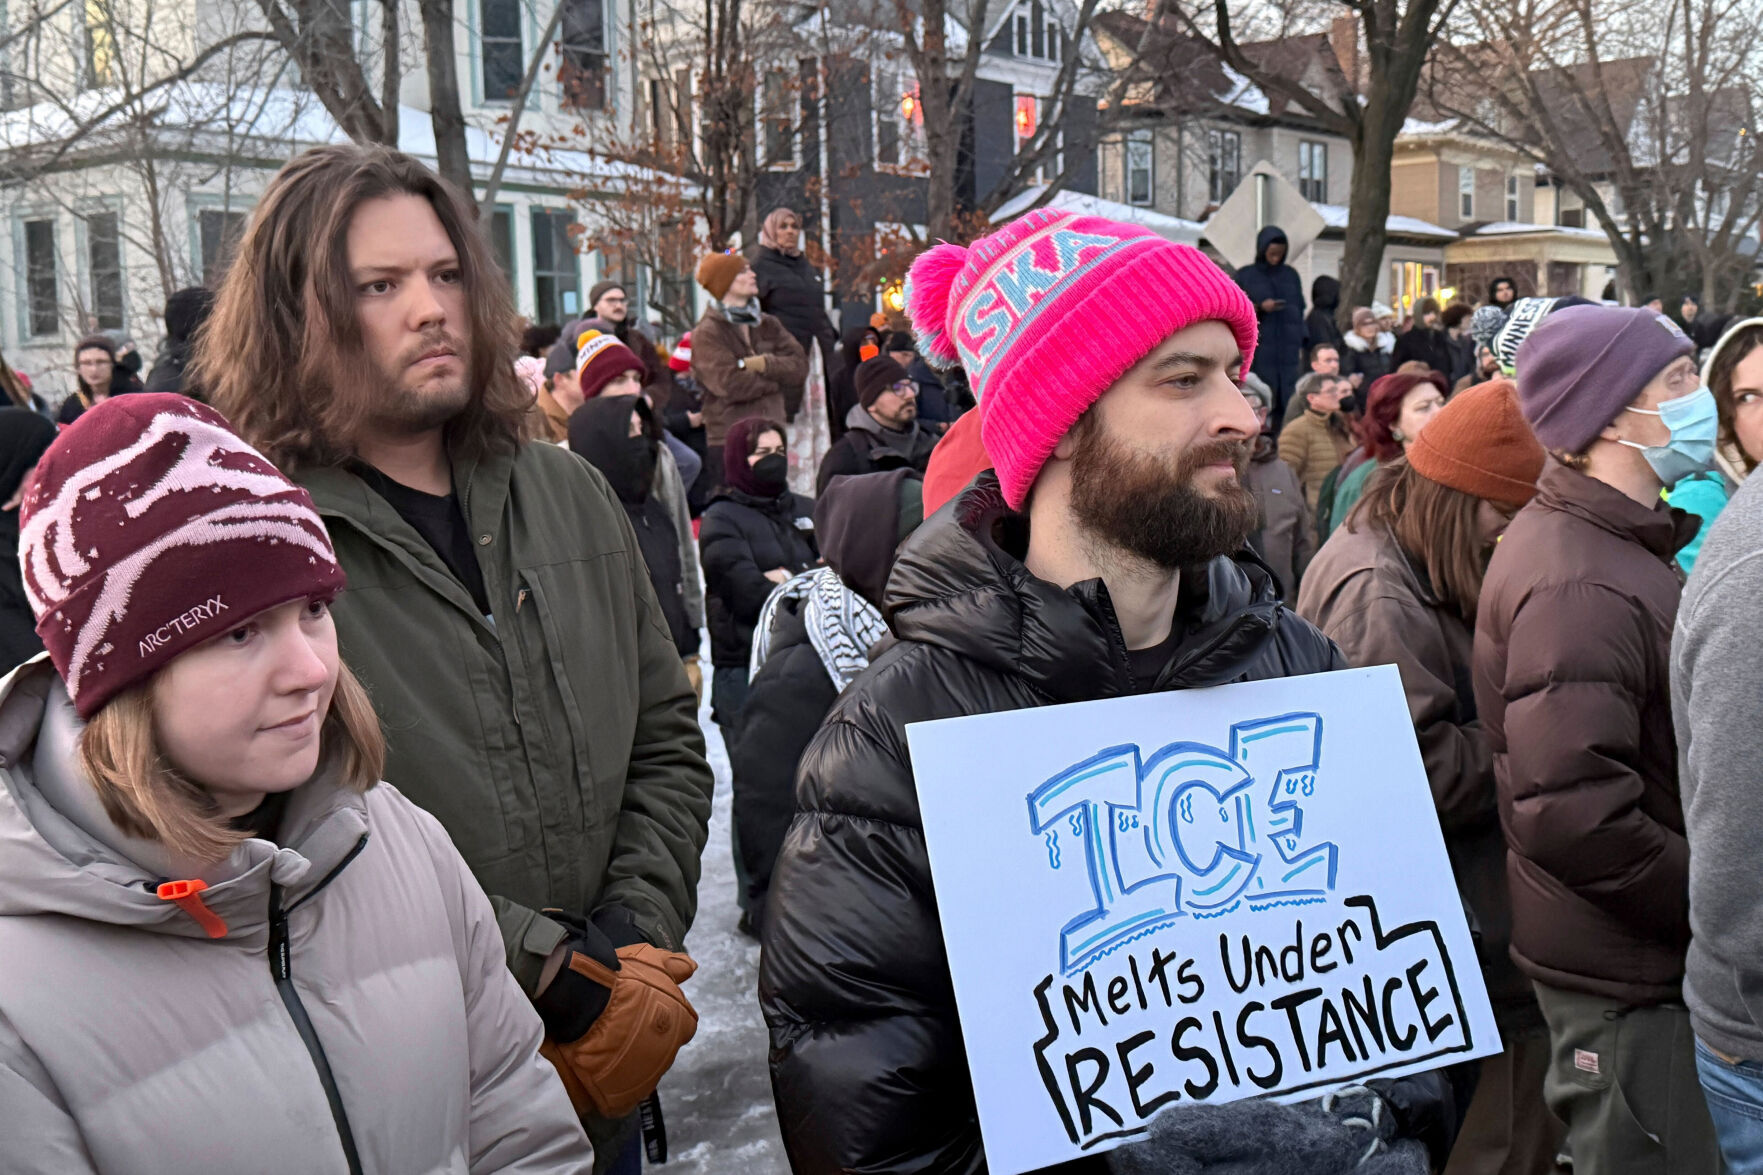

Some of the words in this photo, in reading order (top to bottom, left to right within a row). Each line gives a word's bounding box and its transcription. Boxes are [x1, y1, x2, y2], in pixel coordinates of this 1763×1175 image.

[1500, 300, 1545, 368] MINNES
[139, 594, 229, 658] ARC'TERYX
[1027, 711, 1340, 976] ICE
[1063, 947, 1205, 1035] Melts
[1219, 918, 1362, 994] Under
[1065, 958, 1454, 1137] RESISTANCE
